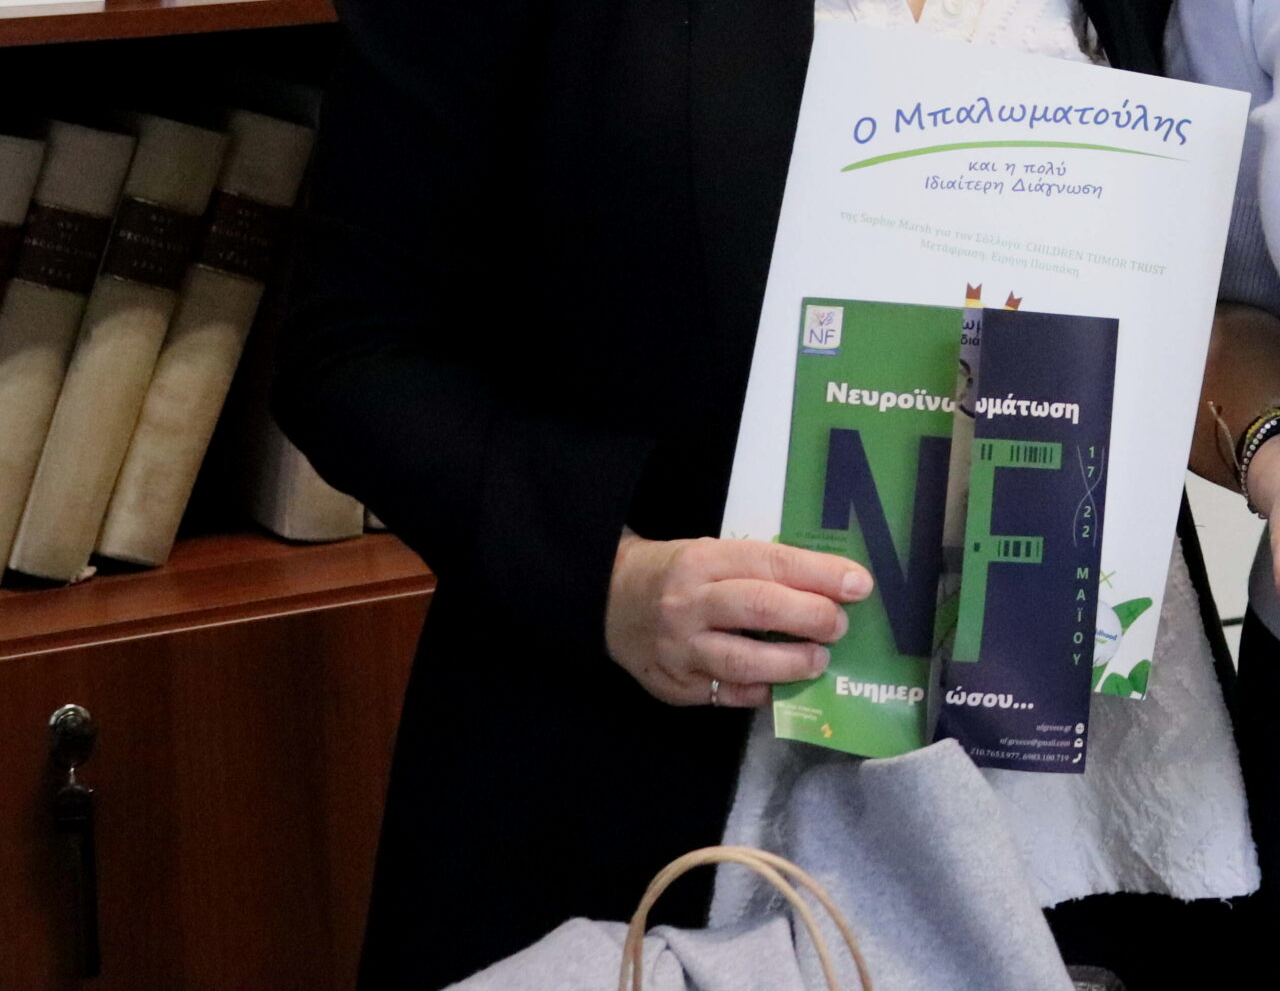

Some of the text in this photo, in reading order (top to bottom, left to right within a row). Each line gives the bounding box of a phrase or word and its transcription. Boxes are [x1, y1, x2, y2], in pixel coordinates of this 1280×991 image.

[853, 97, 1192, 146] Ο Μπαλωματούλης
[969, 161, 1067, 176] και η πολύ
[925, 174, 1103, 199] Ιδιαίτερη Διάγνωση
[860, 212, 896, 227] Sophie
[898, 219, 931, 234] Marsh
[1026, 241, 1085, 261] CHILDREN
[1086, 252, 1128, 269] TUMOR
[1130, 260, 1167, 276] TRUST
[809, 328, 836, 345] NF
[836, 676, 1034, 710] Ενημερ ώσου...
